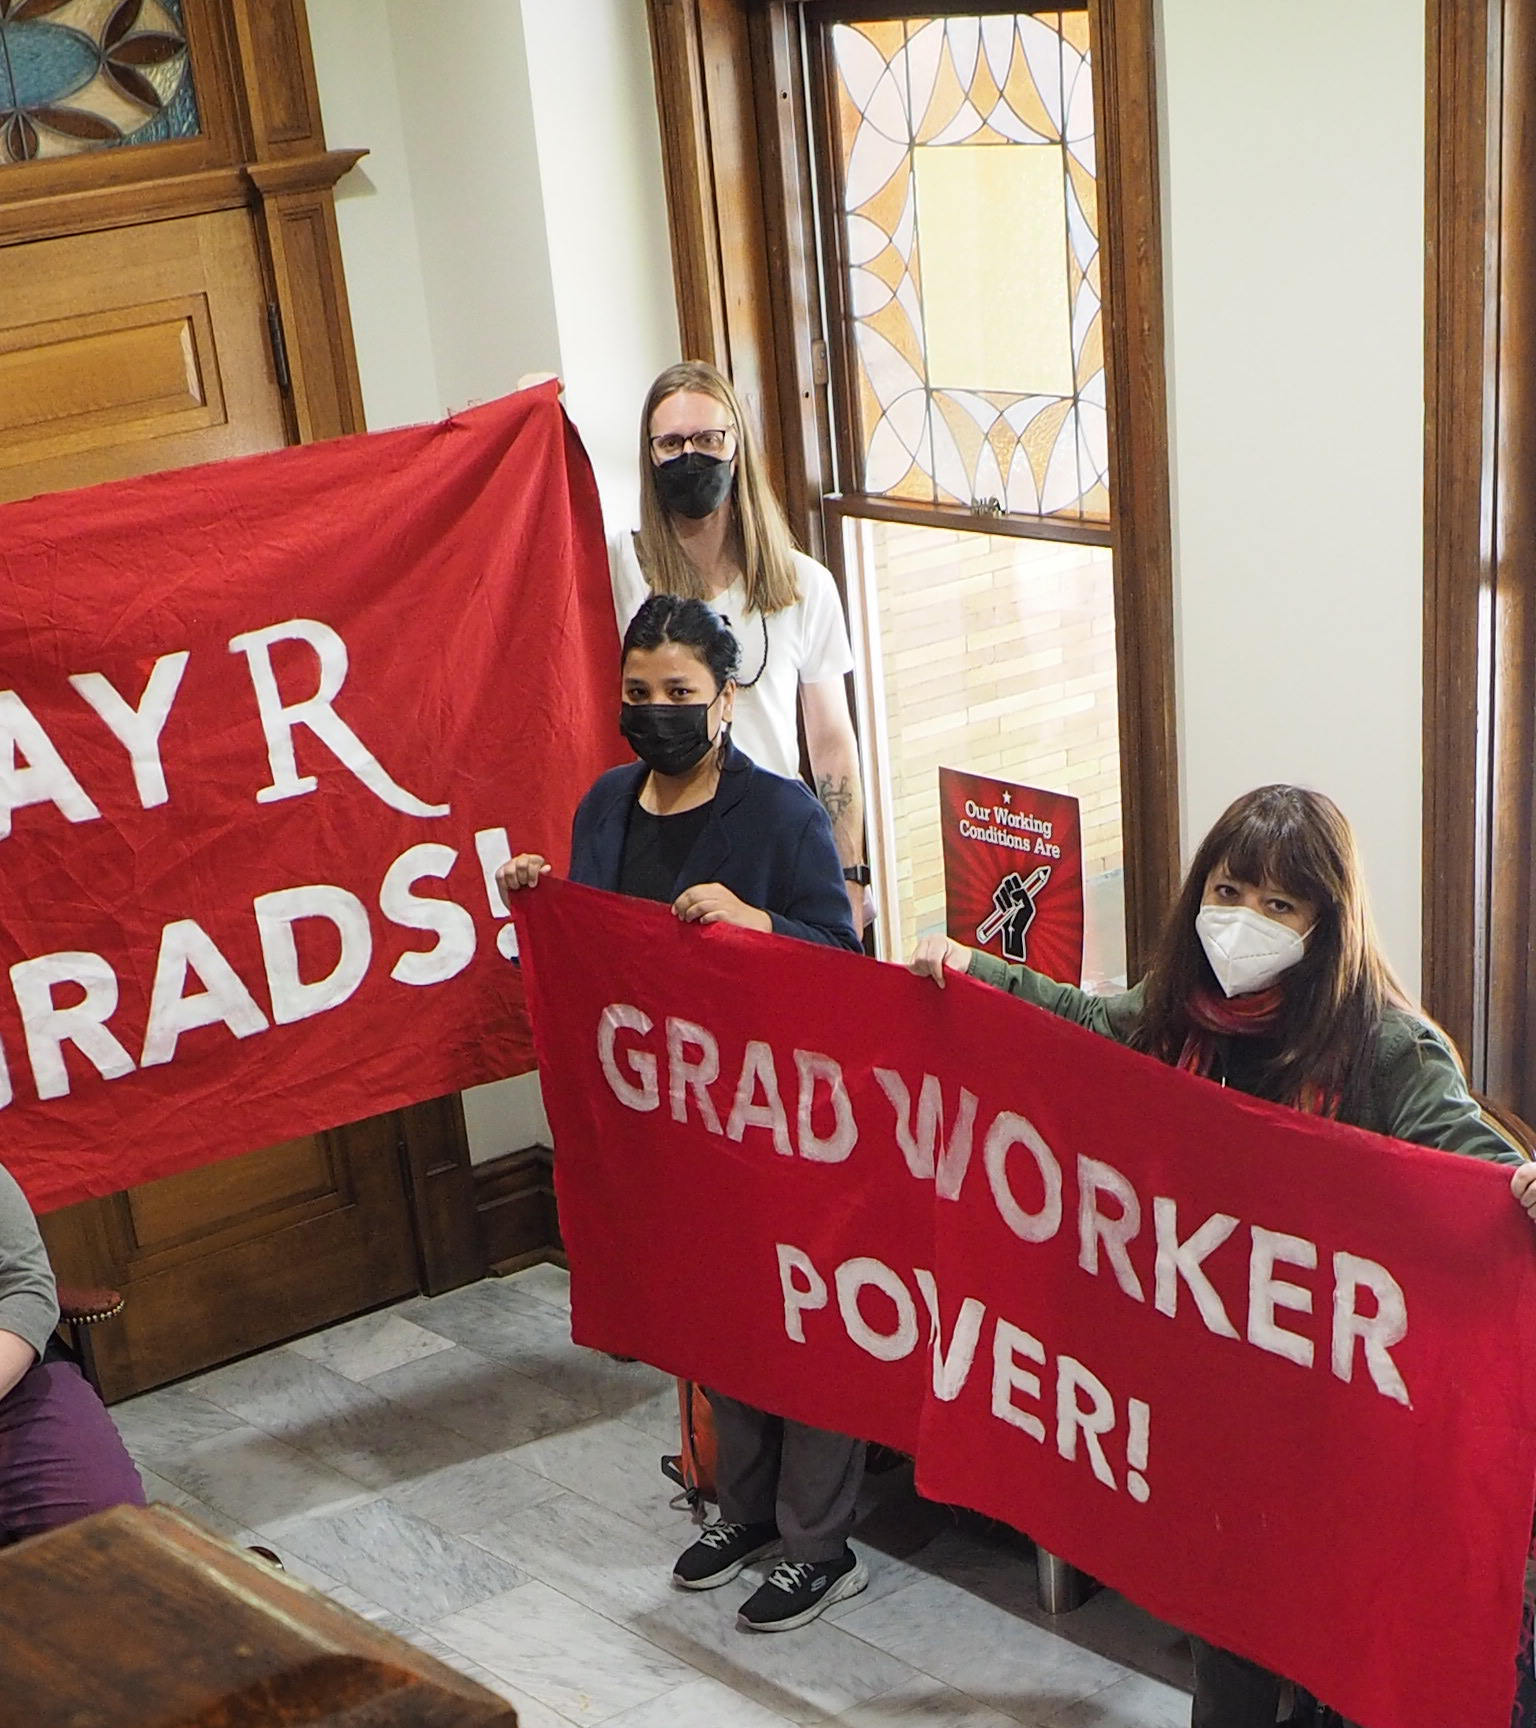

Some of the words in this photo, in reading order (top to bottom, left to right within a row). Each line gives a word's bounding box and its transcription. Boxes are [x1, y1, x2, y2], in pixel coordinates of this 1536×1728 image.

[228, 618, 451, 818] R
[959, 819, 1031, 852] Conditions
[1034, 838, 1061, 860] Are
[965, 800, 991, 822] Our
[993, 806, 1052, 840] Working
[597, 1002, 860, 1164] GRAD
[872, 1066, 1415, 1412] WORKER
